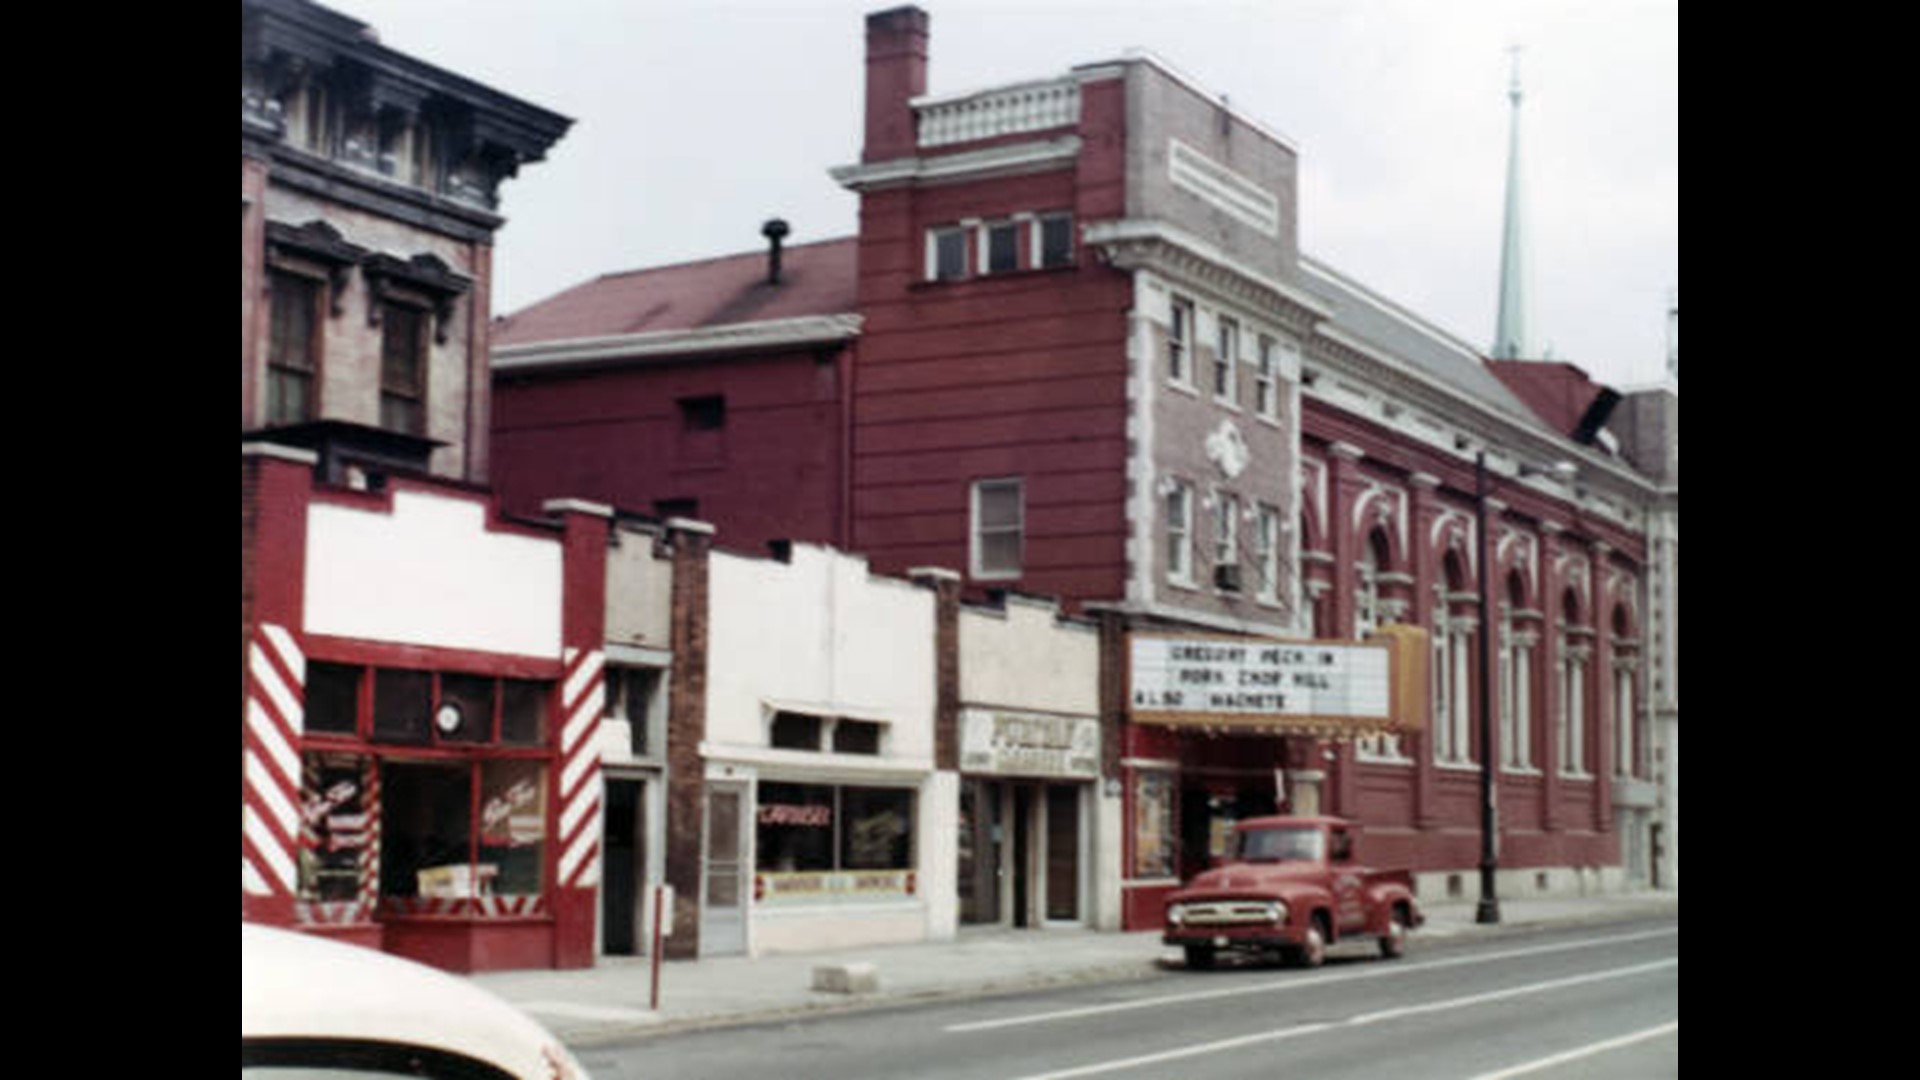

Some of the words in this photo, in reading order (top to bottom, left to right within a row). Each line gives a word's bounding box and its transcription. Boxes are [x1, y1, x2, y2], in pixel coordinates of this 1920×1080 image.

[1261, 649, 1304, 665] PECK
[1180, 668, 1225, 684] PORK
[1238, 670, 1283, 686] CHOP
[1293, 672, 1330, 689] HILL
[1135, 689, 1184, 706] ALSO
[1210, 693, 1286, 710] MACHETE
